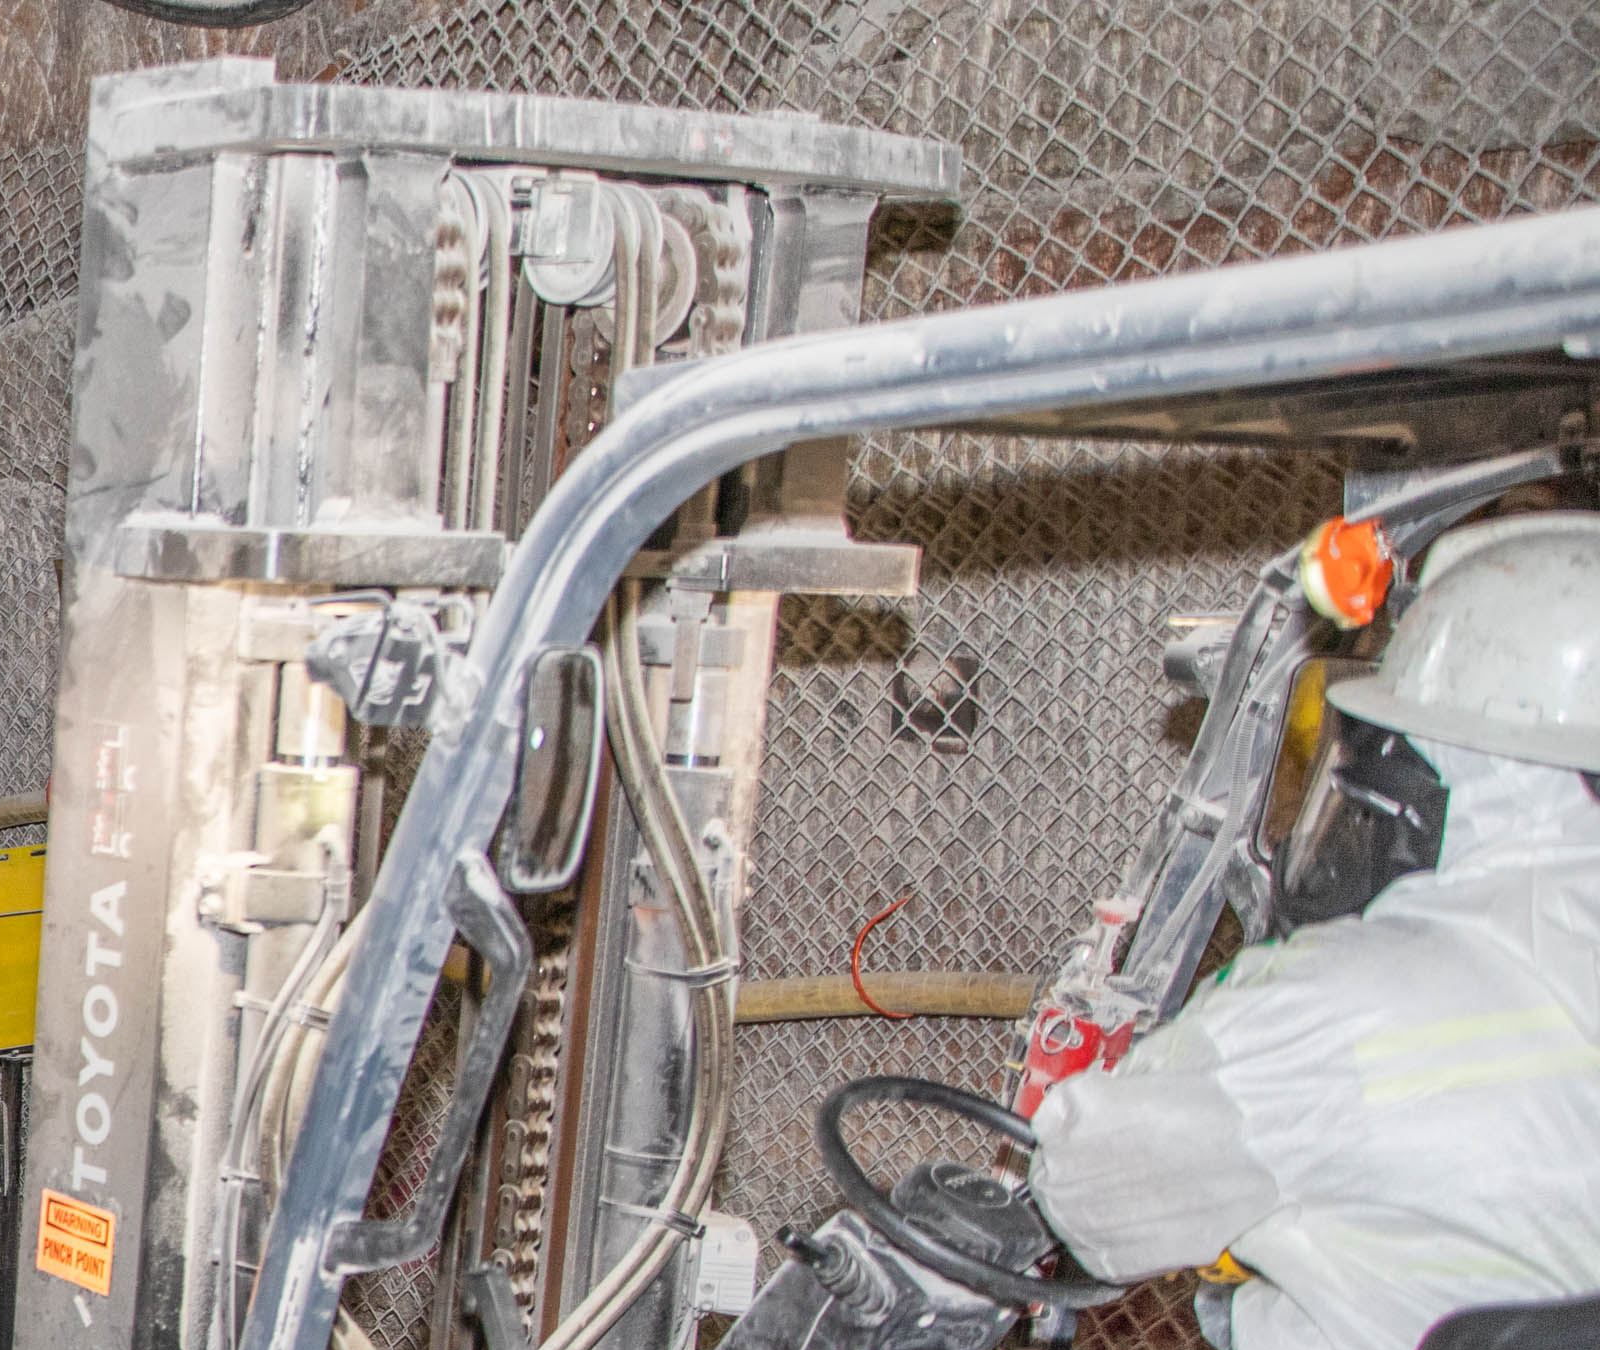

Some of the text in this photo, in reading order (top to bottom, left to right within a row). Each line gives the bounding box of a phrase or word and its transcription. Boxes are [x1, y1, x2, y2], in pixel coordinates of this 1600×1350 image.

[73, 880, 127, 1192] TOYOTA
[53, 1206, 102, 1239] WARNING
[43, 1237, 105, 1278] PINCH POINT
